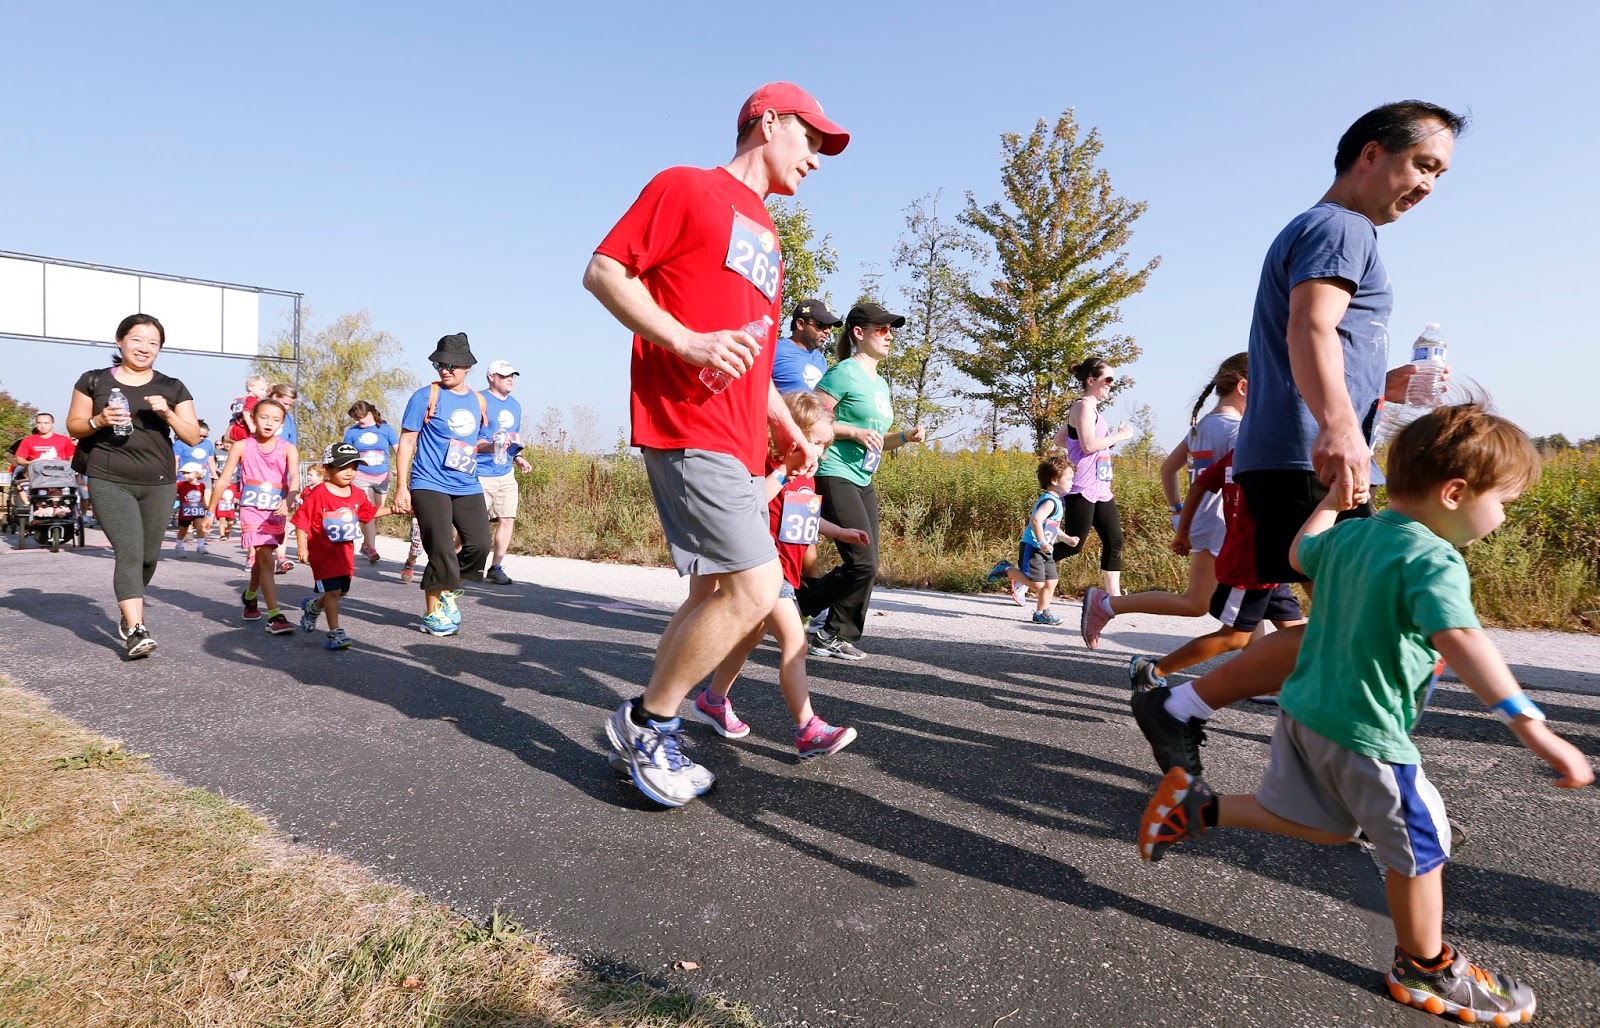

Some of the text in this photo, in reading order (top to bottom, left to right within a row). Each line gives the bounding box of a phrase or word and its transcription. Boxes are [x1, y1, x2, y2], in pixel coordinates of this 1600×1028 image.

[733, 240, 779, 297] 263
[449, 452, 477, 473] 327
[1099, 467, 1113, 480] 34
[243, 490, 282, 510] 292
[184, 507, 205, 516] 296
[327, 522, 363, 541] 328
